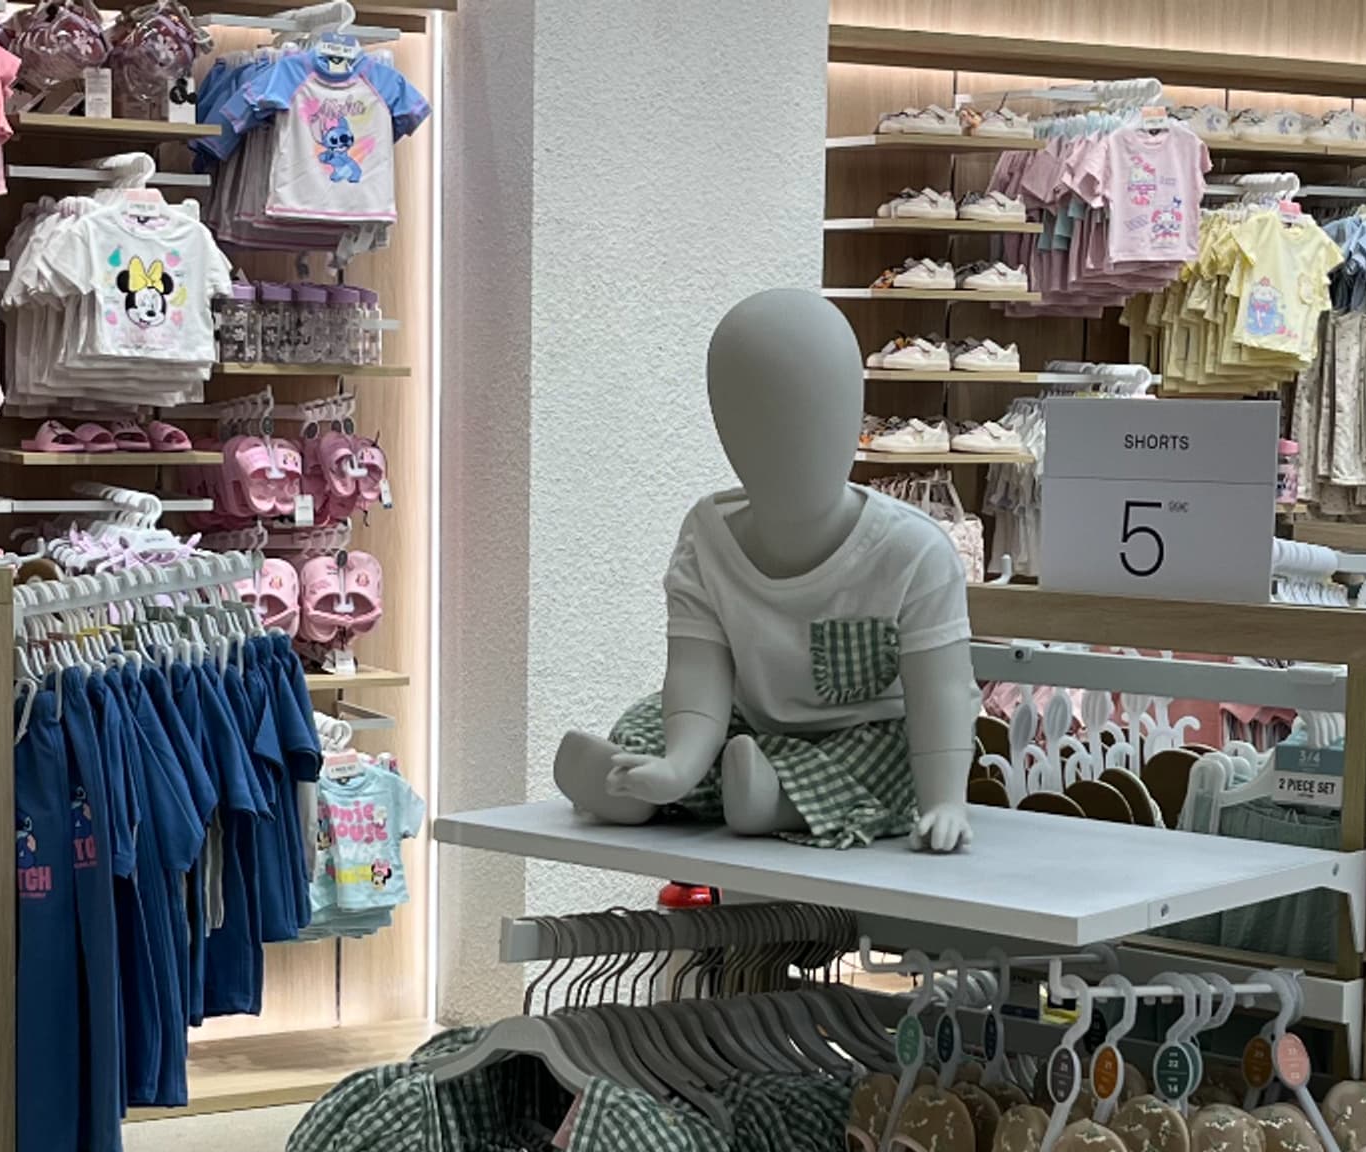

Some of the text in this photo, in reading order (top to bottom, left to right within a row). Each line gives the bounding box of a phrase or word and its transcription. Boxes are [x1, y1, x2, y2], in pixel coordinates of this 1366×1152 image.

[1124, 434, 1190, 450] SHORTS
[1120, 500, 1164, 577] 5
[1298, 749, 1321, 762] 3/4
[1279, 777, 1336, 795] 2 PIECE SET
